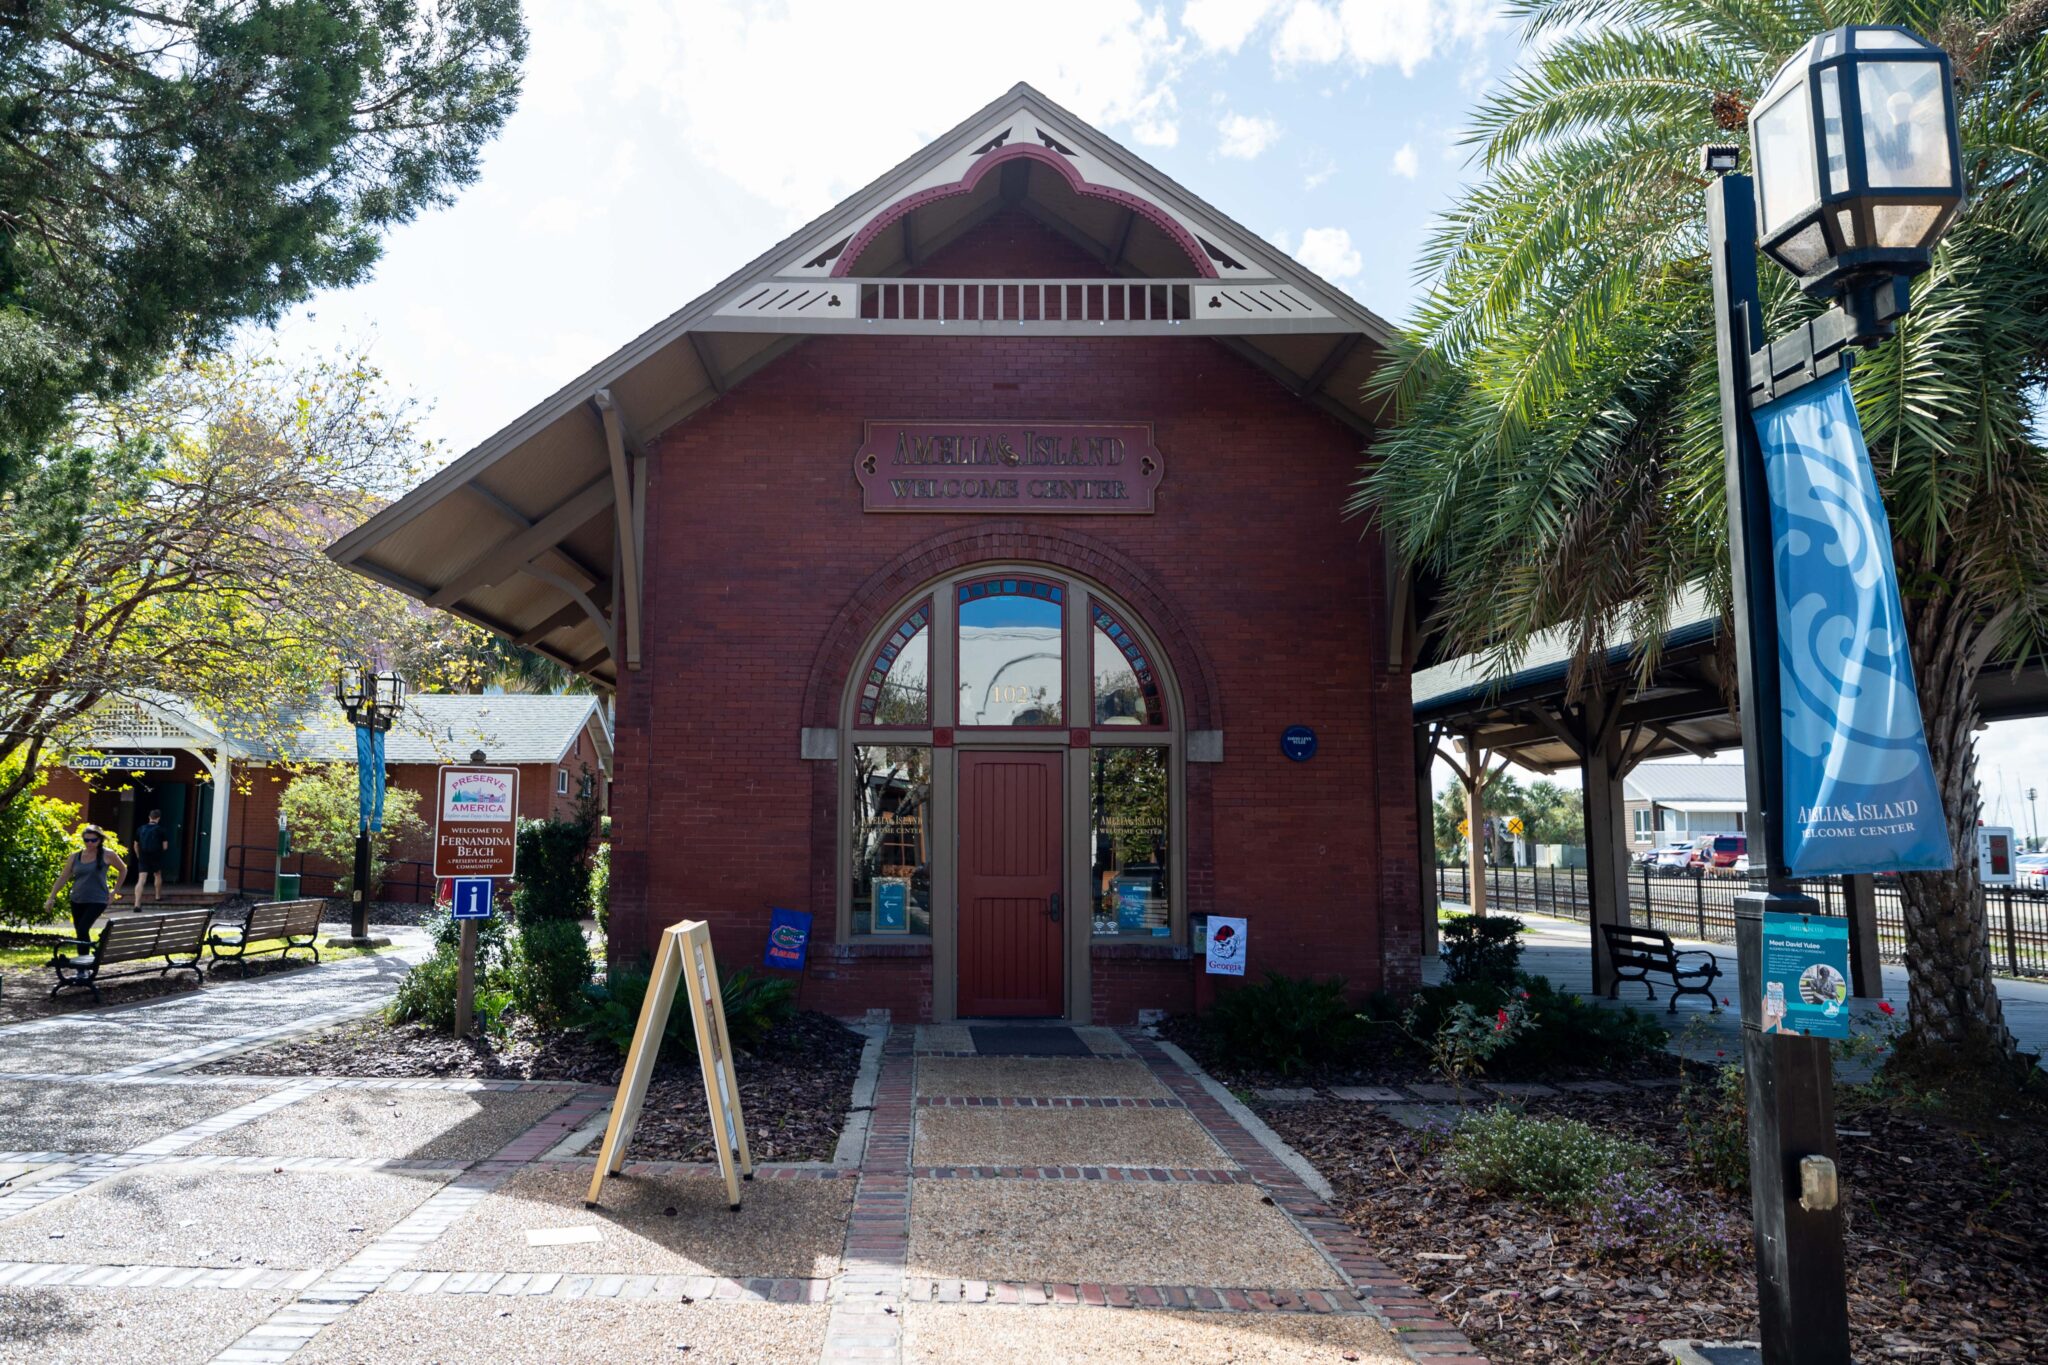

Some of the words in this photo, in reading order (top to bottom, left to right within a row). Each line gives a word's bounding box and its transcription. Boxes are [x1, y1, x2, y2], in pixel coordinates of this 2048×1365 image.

[891, 431, 999, 465] AMELIA
[1023, 430, 1126, 466] ISLAND
[888, 478, 1020, 500] WELCOME
[1025, 479, 1130, 500] CENTER
[992, 686, 1028, 704] 102
[127, 758, 169, 768] Station
[451, 774, 507, 792] PRESERVE
[451, 804, 505, 813] AMERICA
[1855, 799, 1918, 821] ISLAND
[1135, 816, 1163, 825] ISLAND
[1860, 822, 1916, 836] CENTER
[441, 835, 512, 846] FERNANDINA
[457, 846, 494, 857] BEACH
[1209, 960, 1242, 973] Georgia
